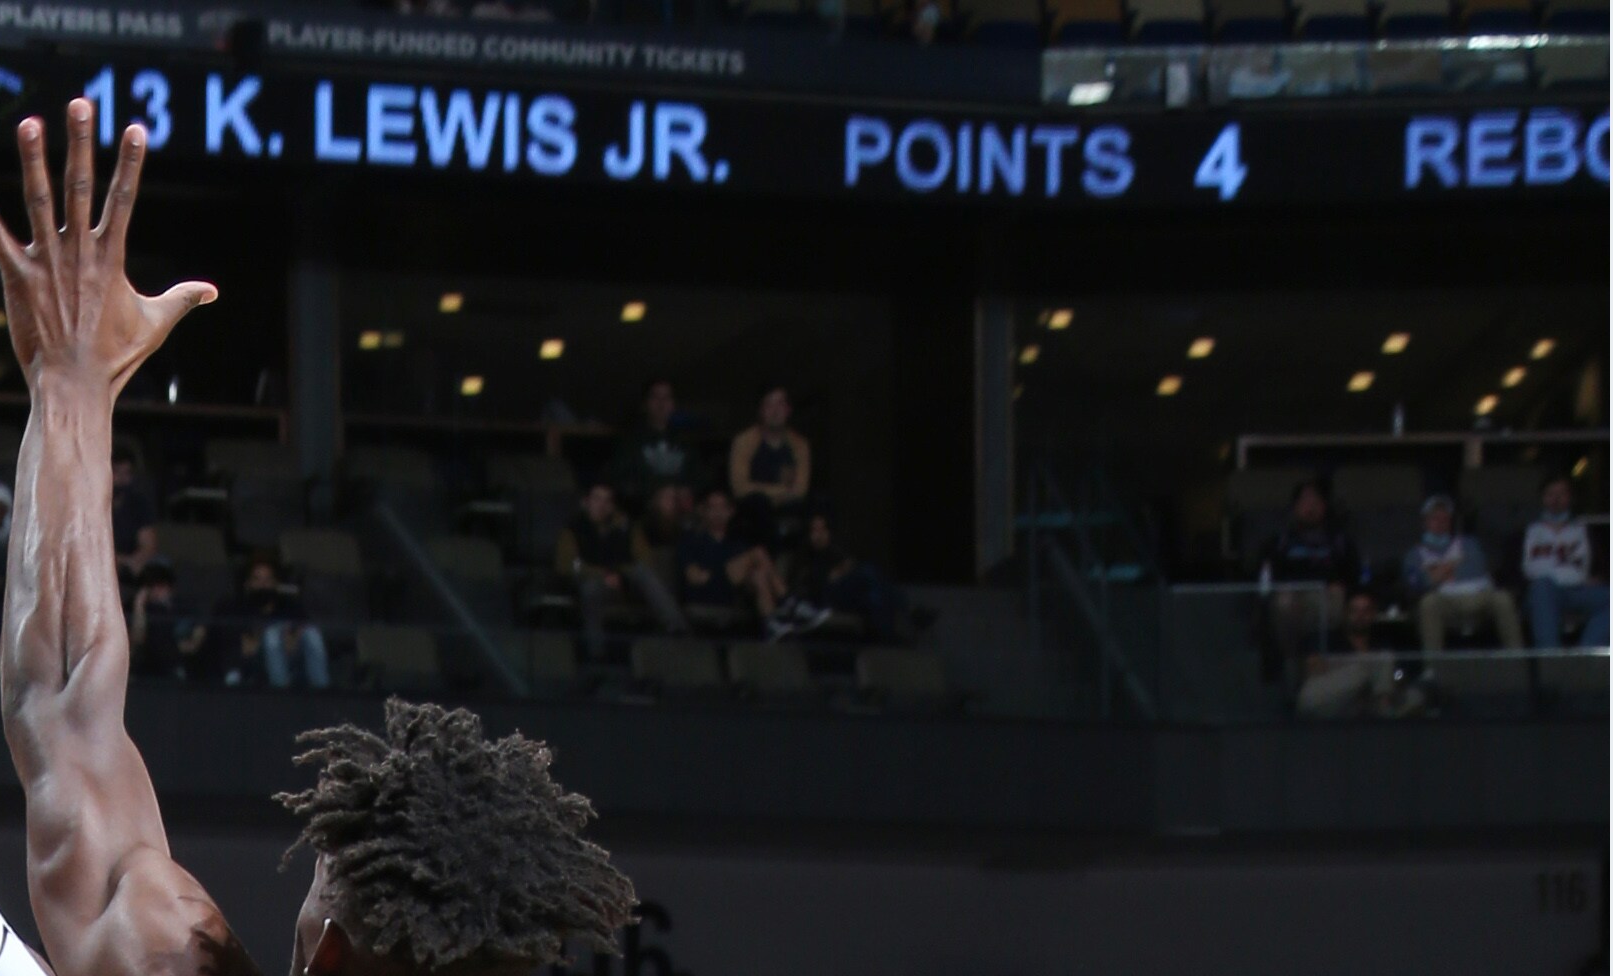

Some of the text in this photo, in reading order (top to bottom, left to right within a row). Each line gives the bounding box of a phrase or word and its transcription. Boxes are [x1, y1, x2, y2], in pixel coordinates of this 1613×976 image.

[117, 10, 183, 39] PASS
[267, 20, 477, 60] PLAYER-FUNDED
[482, 34, 634, 70] COMMUNITY
[642, 45, 745, 75] TICKETS
[83, 64, 732, 184] 13 K. LEWIS JR.
[844, 115, 1248, 200] POINTS 4
